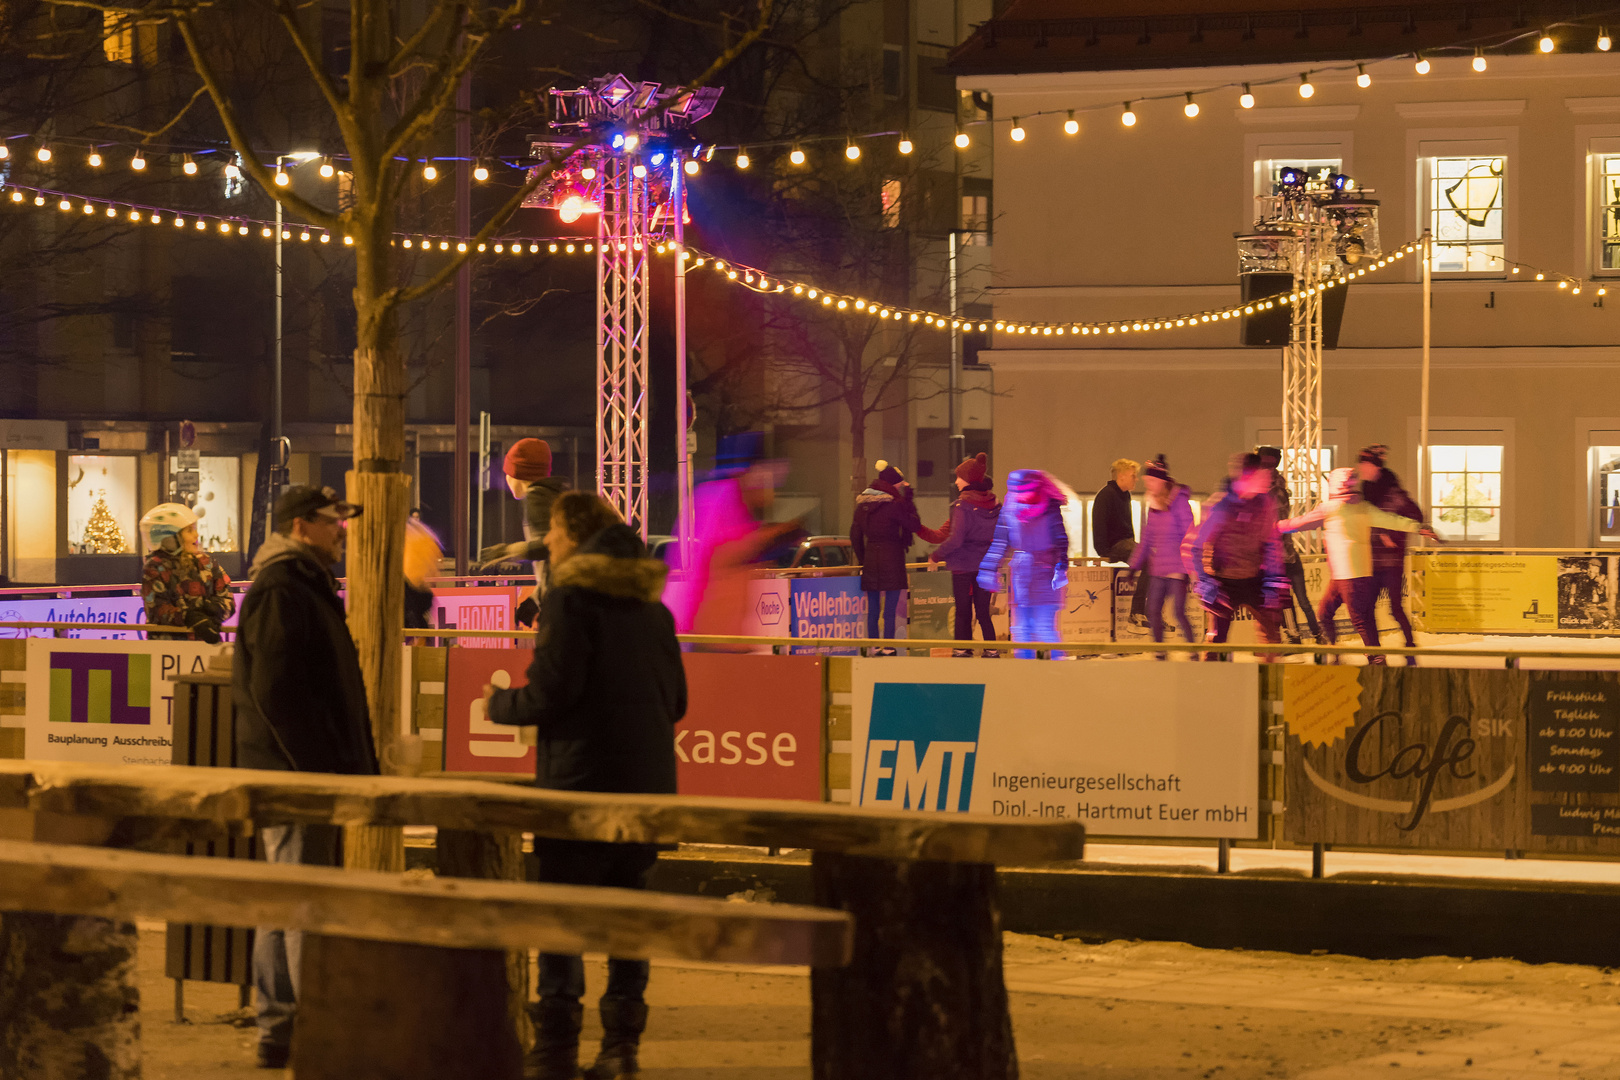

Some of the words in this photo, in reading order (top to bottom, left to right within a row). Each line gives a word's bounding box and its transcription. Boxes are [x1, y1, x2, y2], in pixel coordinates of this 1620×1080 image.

[761, 601, 780, 615] Roche
[794, 591, 869, 618] Wellenbad
[460, 606, 503, 631] HOME
[798, 617, 866, 639] Penzberg
[1546, 690, 1607, 702] Frühstück
[1553, 709, 1600, 722] Täglich
[1477, 718, 1513, 737] SIK
[1539, 727, 1555, 737] ab
[1558, 728, 1586, 738] 8:00
[1589, 727, 1614, 739] Uhr
[48, 733, 107, 747] Bauplanung
[113, 736, 173, 747] Ausschreibu
[674, 729, 798, 767] kasse
[1549, 744, 1604, 760] Sonntags
[1539, 763, 1555, 774] ab
[1558, 763, 1586, 775] 9:00
[1589, 763, 1614, 775] Uhr
[992, 772, 1181, 793] Ingenieurgesellschaft
[992, 800, 1071, 819] Dipl.-Ing.
[1077, 802, 1153, 820] Hartmut
[1159, 804, 1200, 820] Euer
[1205, 805, 1248, 822] mbH
[1559, 807, 1600, 821] Ludwig
